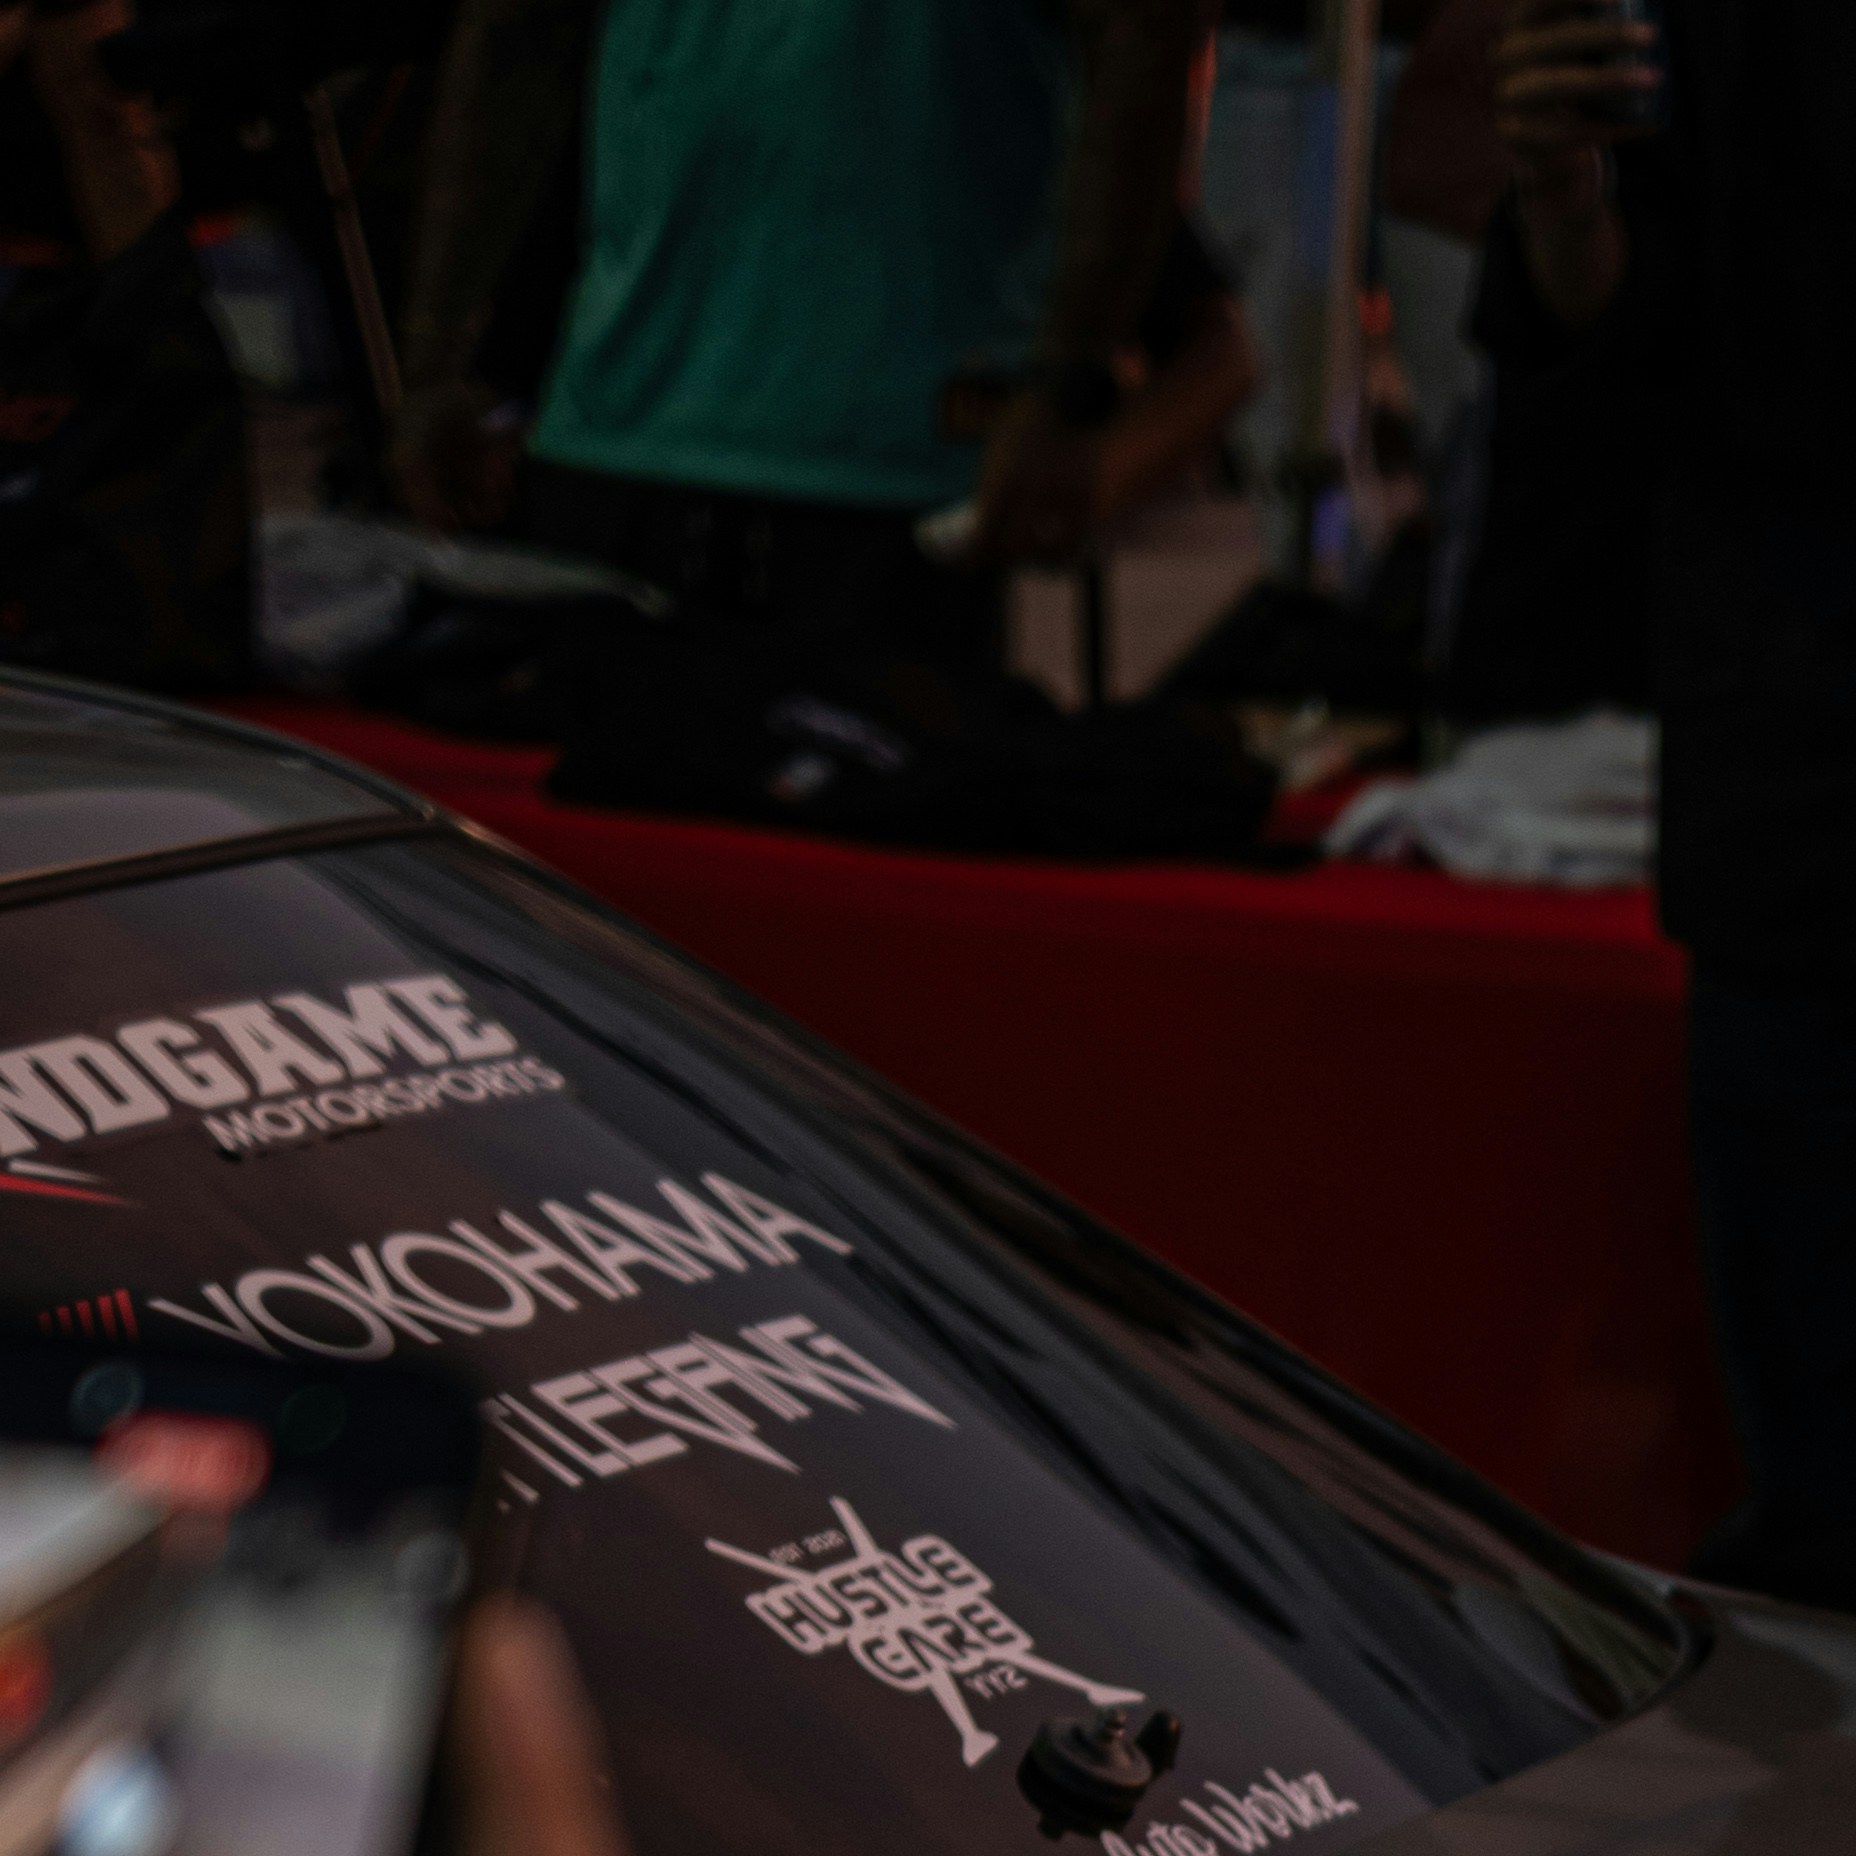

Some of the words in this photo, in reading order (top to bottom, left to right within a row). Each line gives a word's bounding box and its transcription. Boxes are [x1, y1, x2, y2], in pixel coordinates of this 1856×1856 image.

[201, 1053, 567, 1151] MOTORSPORTS
[148, 1174, 854, 1362] YOKOHAMA
[478, 1314, 957, 1511] TLEGANG
